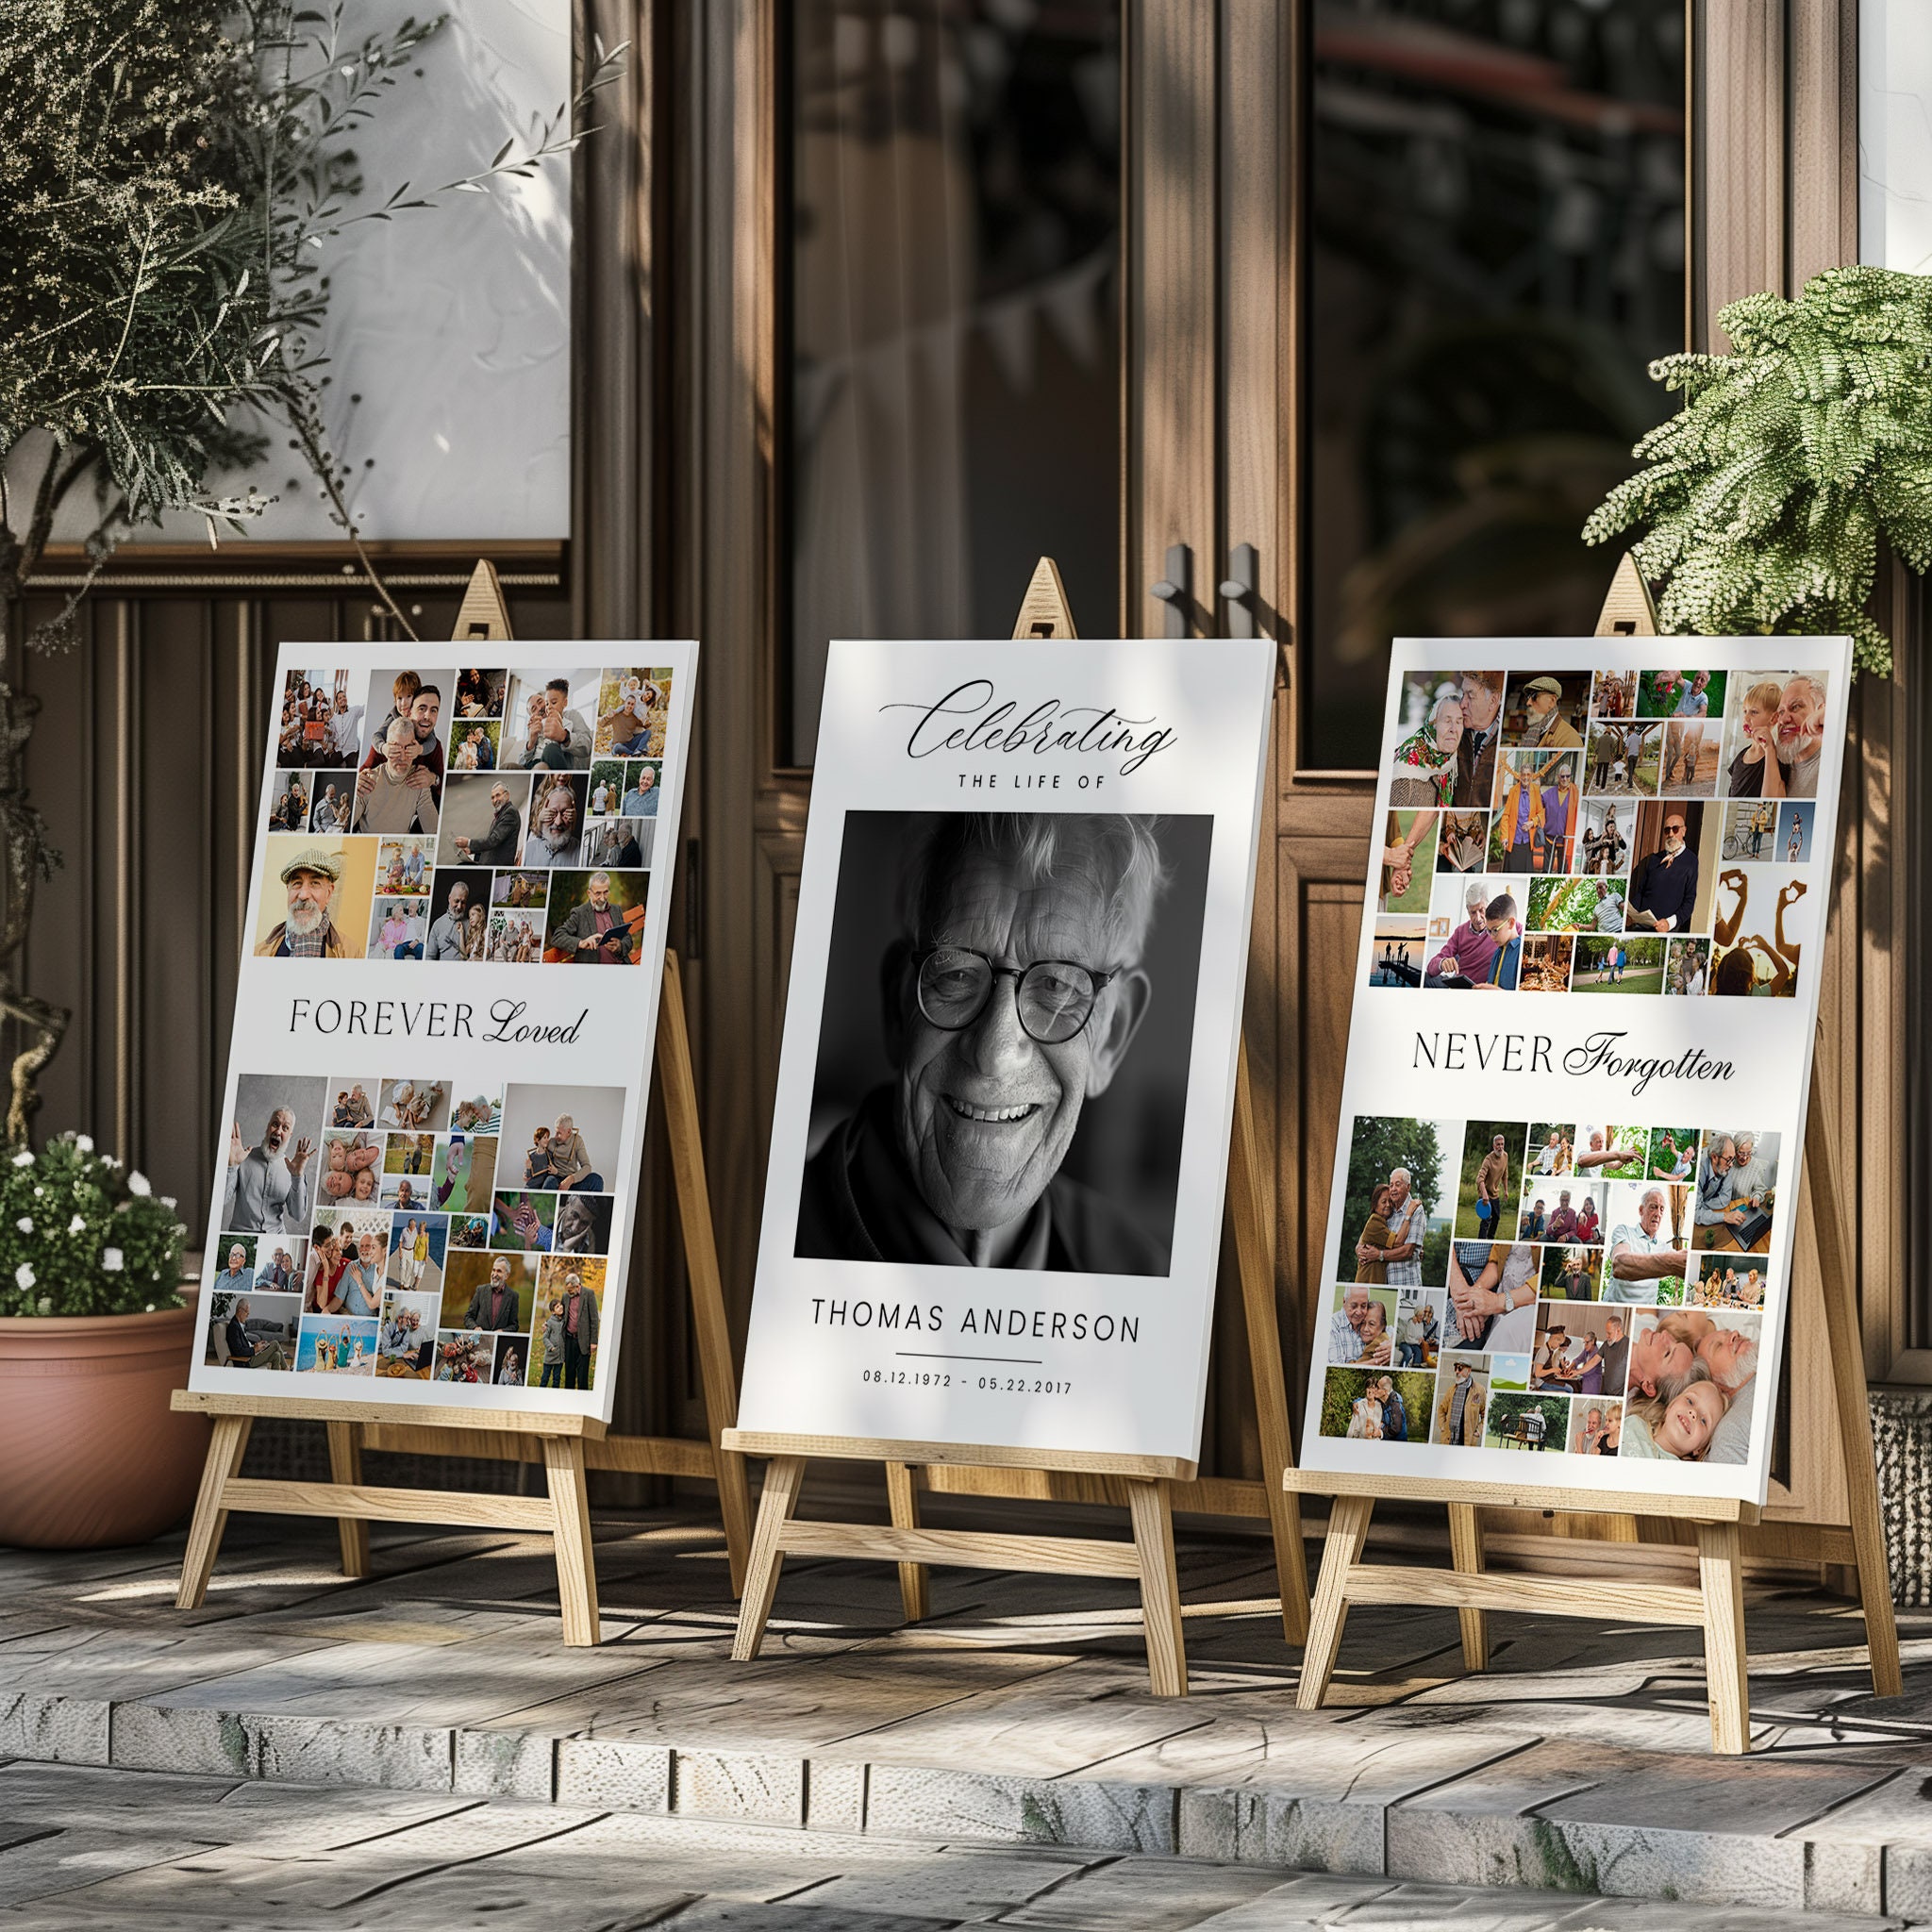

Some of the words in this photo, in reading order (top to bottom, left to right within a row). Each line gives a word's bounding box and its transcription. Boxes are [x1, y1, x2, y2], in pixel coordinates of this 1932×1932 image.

[878, 679, 1178, 776] Celebrating
[958, 774, 997, 789] THE
[1014, 774, 1060, 789] LIFE
[1077, 774, 1105, 790] OF
[289, 998, 474, 1039] FOREVER
[482, 998, 590, 1044] Loved
[1412, 1032, 1553, 1074] NEVER
[1562, 1031, 1736, 1097] Forgotten
[811, 1298, 943, 1332] THOMAS
[959, 1307, 1140, 1343] ANDERSON
[863, 1369, 951, 1388] 08.12.1972
[978, 1376, 1072, 1394] 05.22.2017
